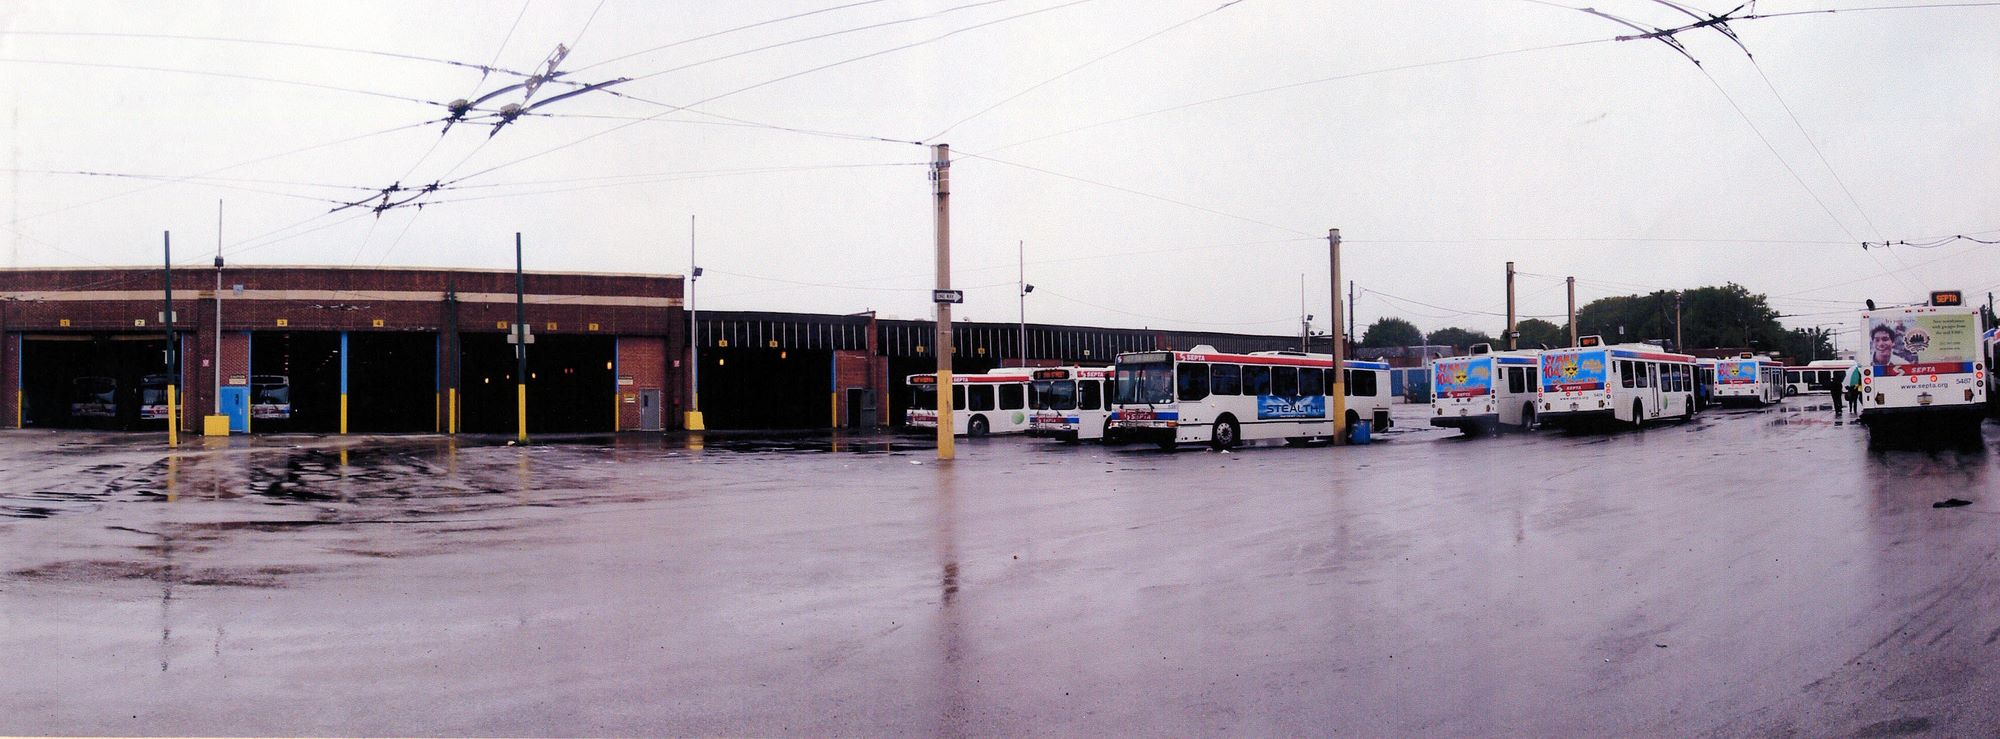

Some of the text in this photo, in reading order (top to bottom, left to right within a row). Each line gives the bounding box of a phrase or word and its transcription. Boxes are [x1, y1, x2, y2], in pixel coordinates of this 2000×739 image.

[1936, 294, 1958, 303] SEPTA
[1901, 382, 1948, 390] www.septa.org
[1266, 404, 1318, 413] STEALTH
